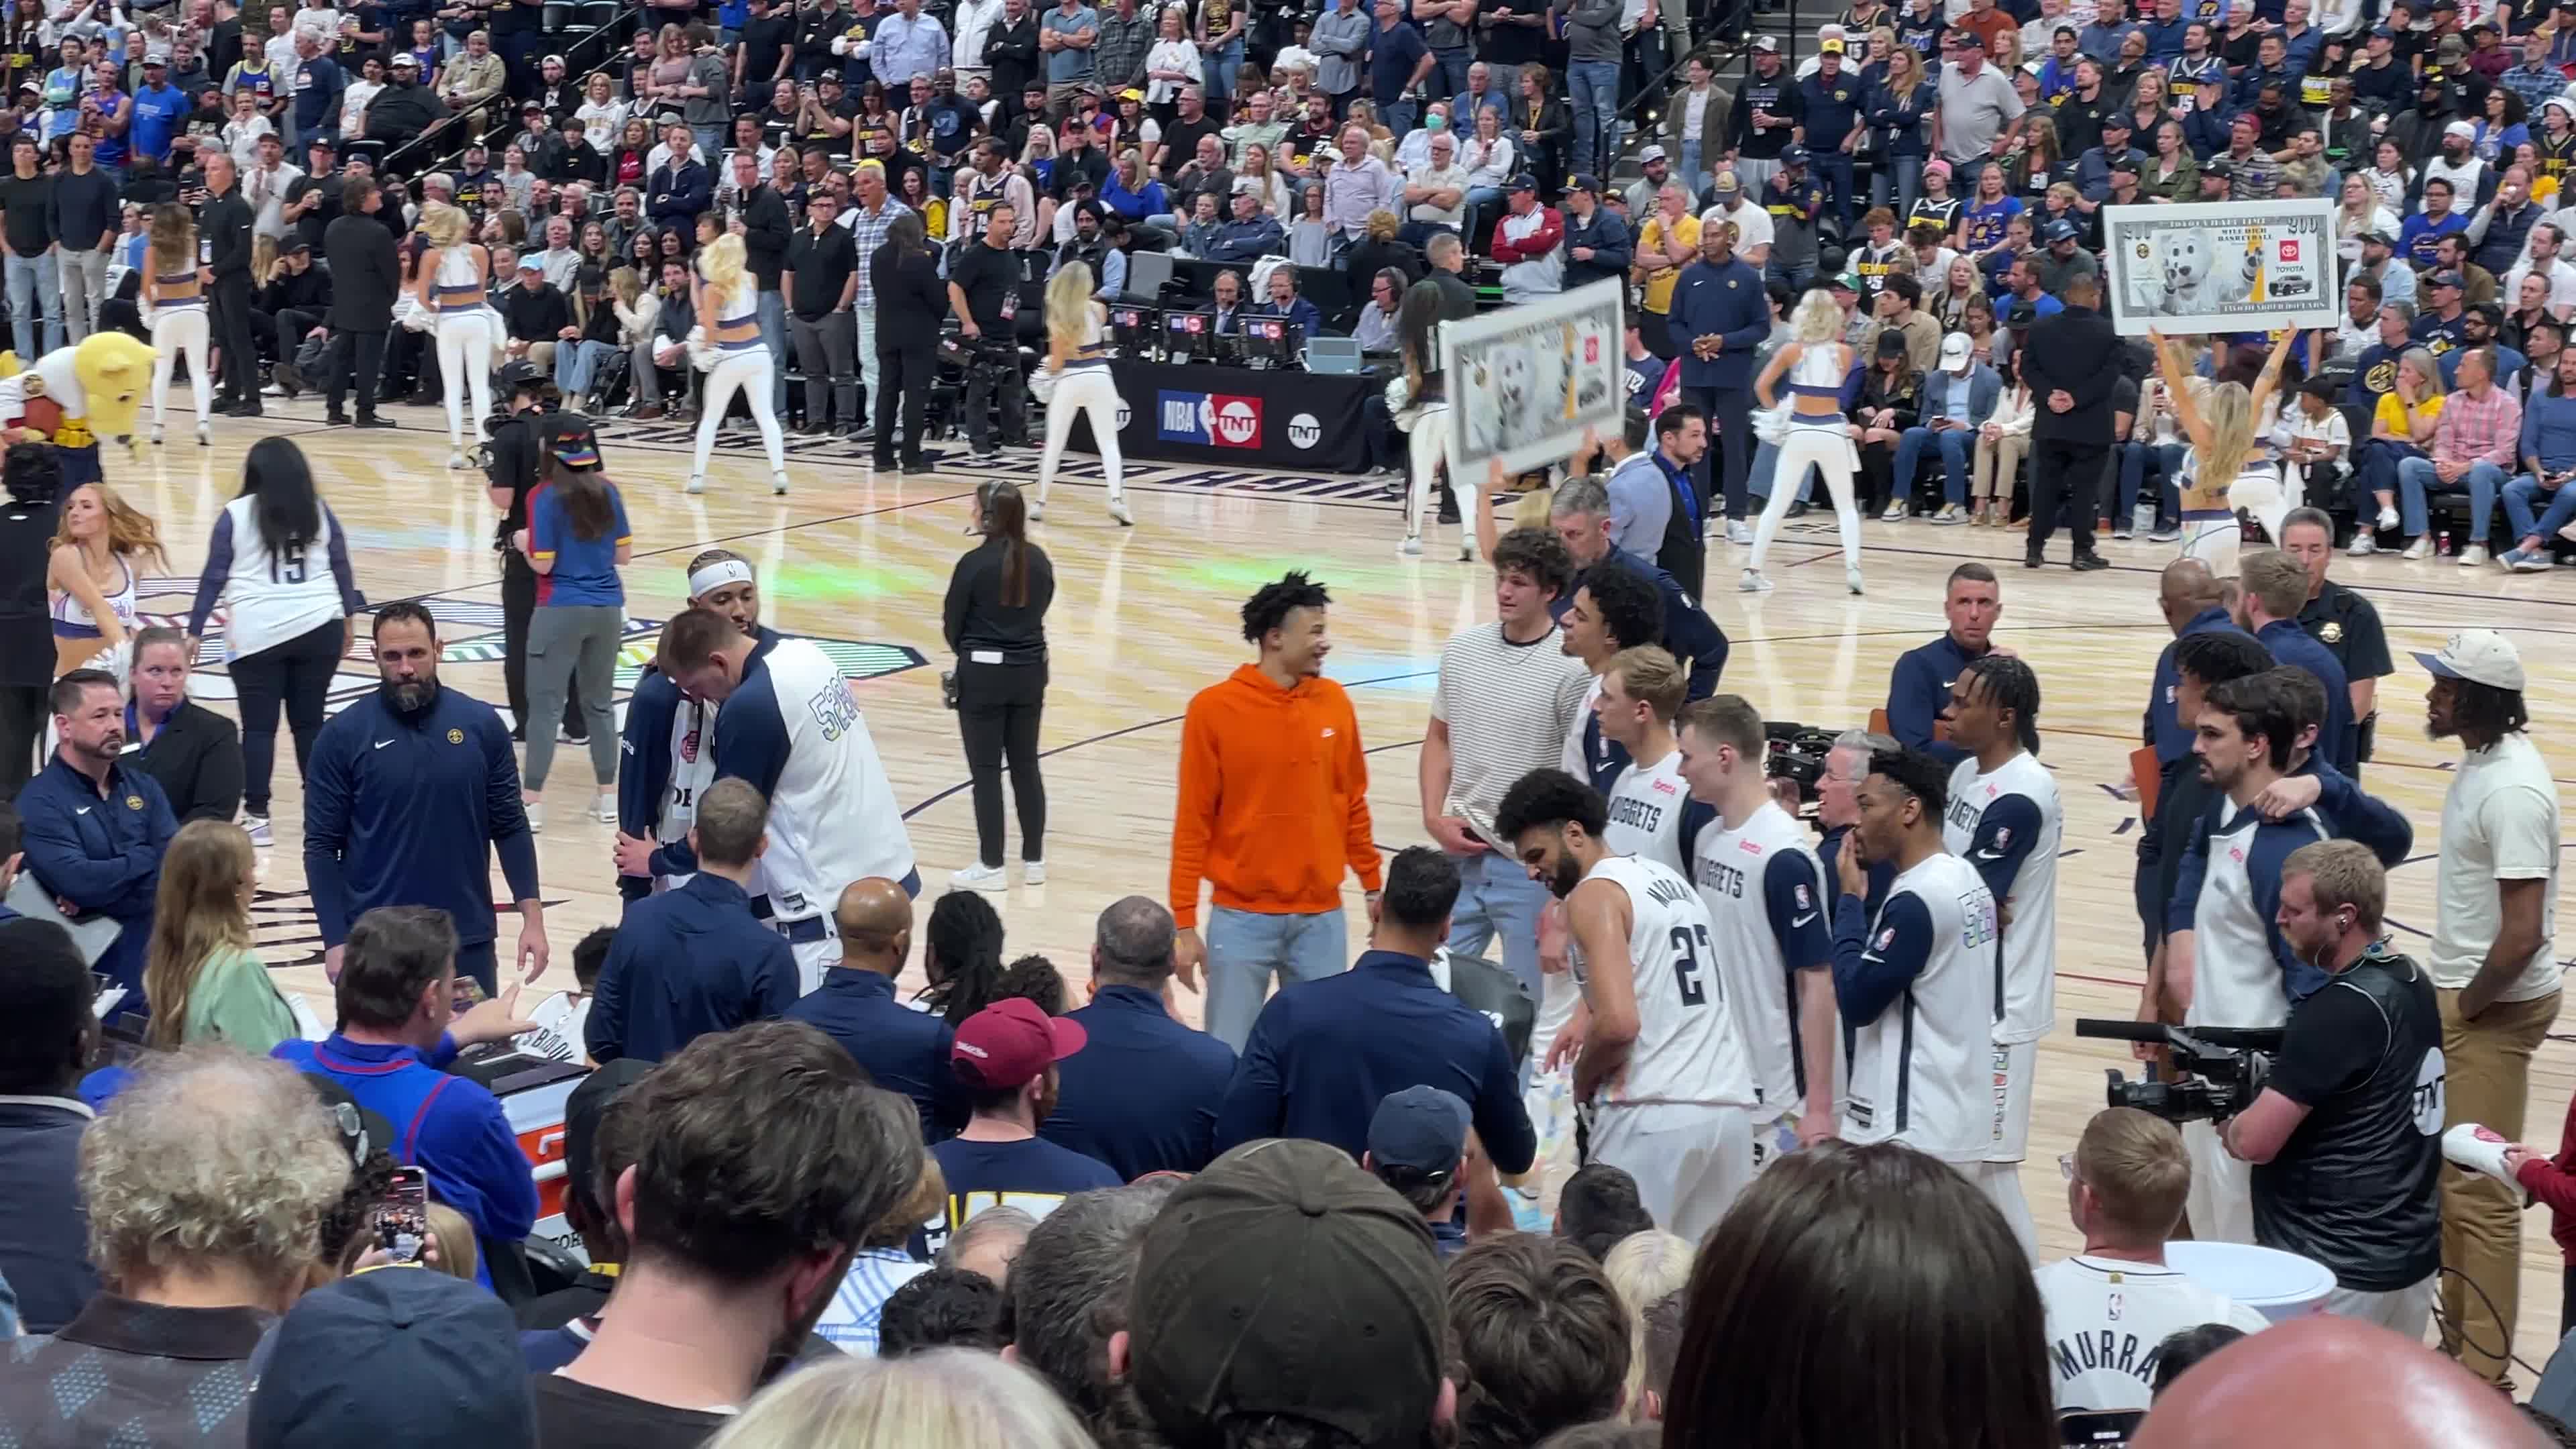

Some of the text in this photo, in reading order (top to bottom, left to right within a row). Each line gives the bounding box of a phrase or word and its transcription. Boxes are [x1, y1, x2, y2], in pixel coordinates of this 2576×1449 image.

[2287, 217, 2318, 235] 200
[2275, 266, 2305, 274] TOYOTA
[1163, 400, 1195, 433] NBA
[1219, 415, 1257, 433] TNT
[1288, 424, 1322, 441] TNT
[1670, 924, 1724, 1007] 27
